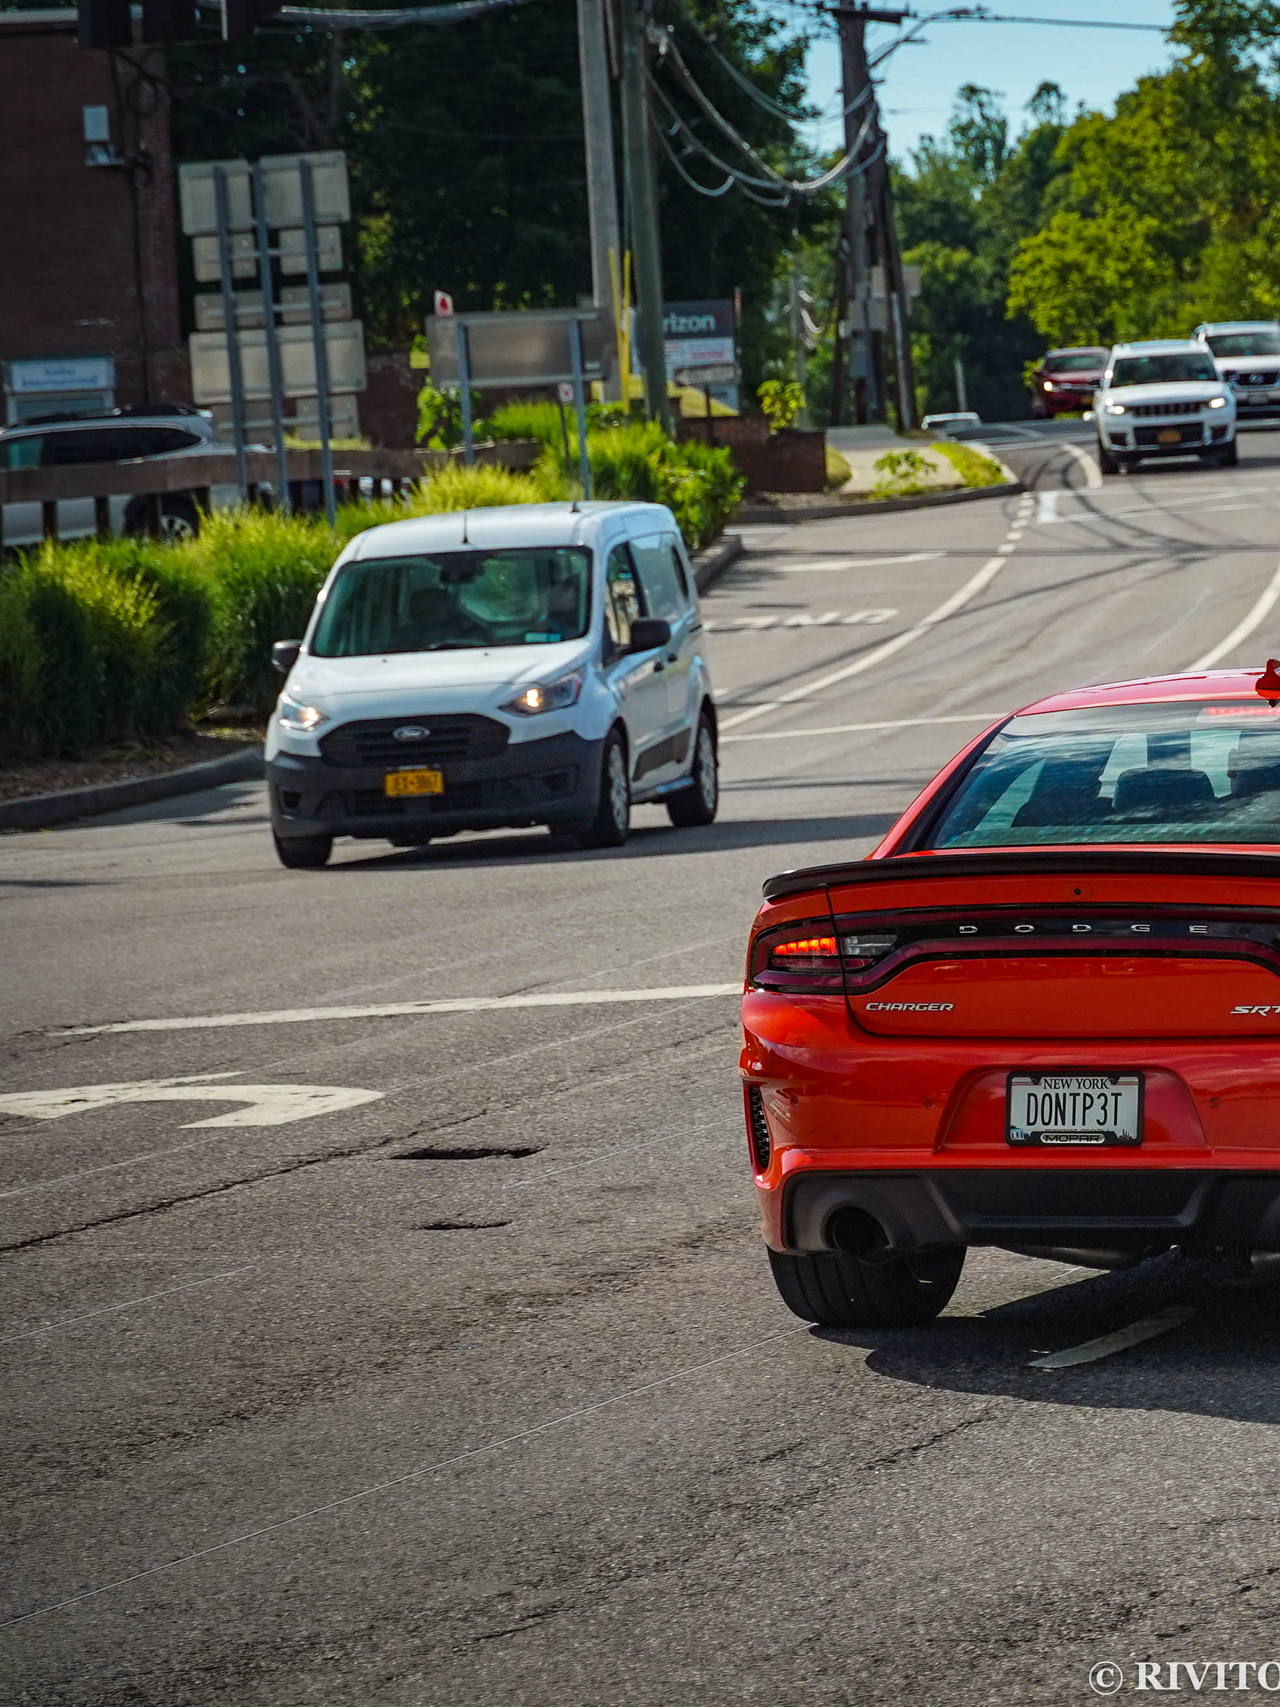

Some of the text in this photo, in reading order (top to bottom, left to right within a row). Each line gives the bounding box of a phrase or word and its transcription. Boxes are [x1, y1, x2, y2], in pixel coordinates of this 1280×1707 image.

[661, 312, 716, 333] rizon
[959, 923, 1208, 935] DODGE
[865, 1001, 954, 1013] CHARGER
[1043, 1078, 1109, 1090] NEW YORK
[1026, 1092, 1123, 1127] DONTP3T
[1044, 1134, 1101, 1143] MOPAR
